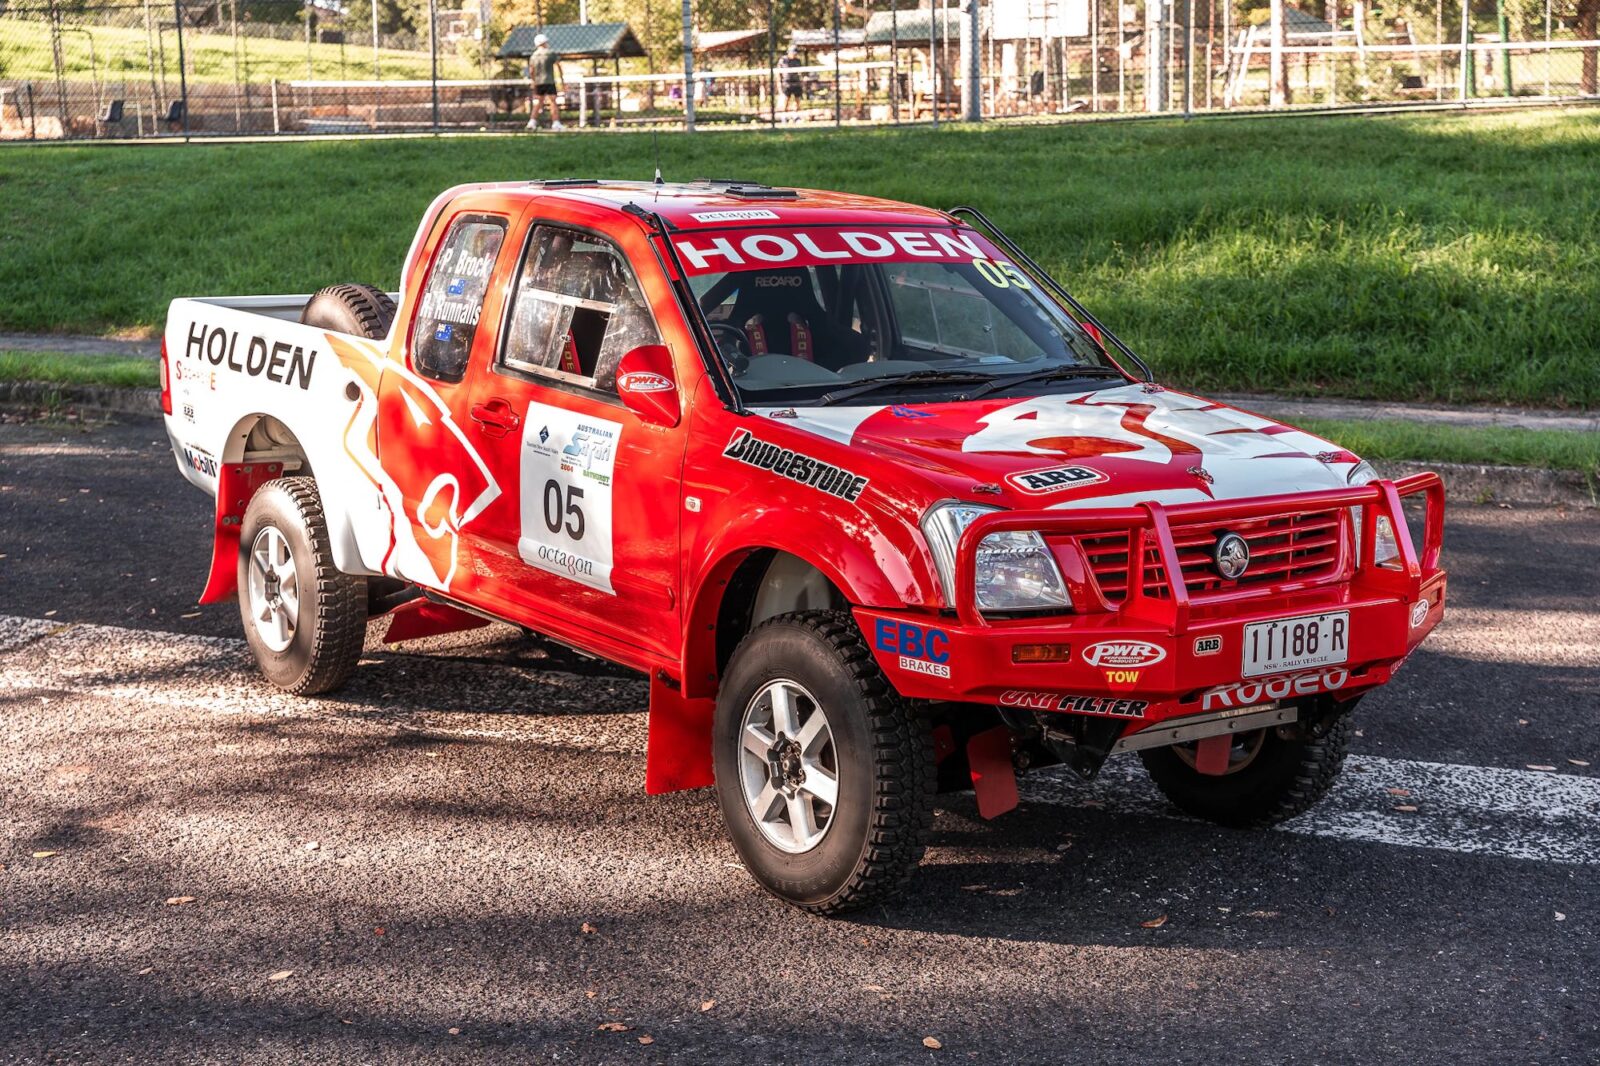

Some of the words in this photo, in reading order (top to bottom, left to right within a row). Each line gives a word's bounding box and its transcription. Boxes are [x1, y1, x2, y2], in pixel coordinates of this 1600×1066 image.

[698, 210, 770, 219] octagon
[676, 232, 986, 269] HOLDEN
[455, 250, 491, 277] Brock
[972, 258, 1031, 290] 05
[755, 276, 801, 287] RECARO
[434, 291, 482, 326] Runnalls
[186, 321, 318, 390] HOLDEN
[625, 376, 665, 391] PWR
[577, 424, 613, 438] AUSTRALIAN
[560, 463, 574, 472] 2004
[1020, 468, 1097, 489] ARB
[543, 479, 585, 541] 05
[538, 545, 593, 576] octagon
[876, 618, 950, 664] EBC
[1197, 640, 1219, 651] ARB
[1091, 644, 1155, 666] PWR
[1263, 663, 1278, 671] NSW
[1282, 659, 1302, 668] RALLY
[1302, 656, 1329, 665] VEHICLE
[900, 658, 949, 677] BRAKES
[1106, 671, 1139, 683] TOW
[1000, 690, 1057, 709] UNI
[1057, 695, 1150, 718] FILTER
